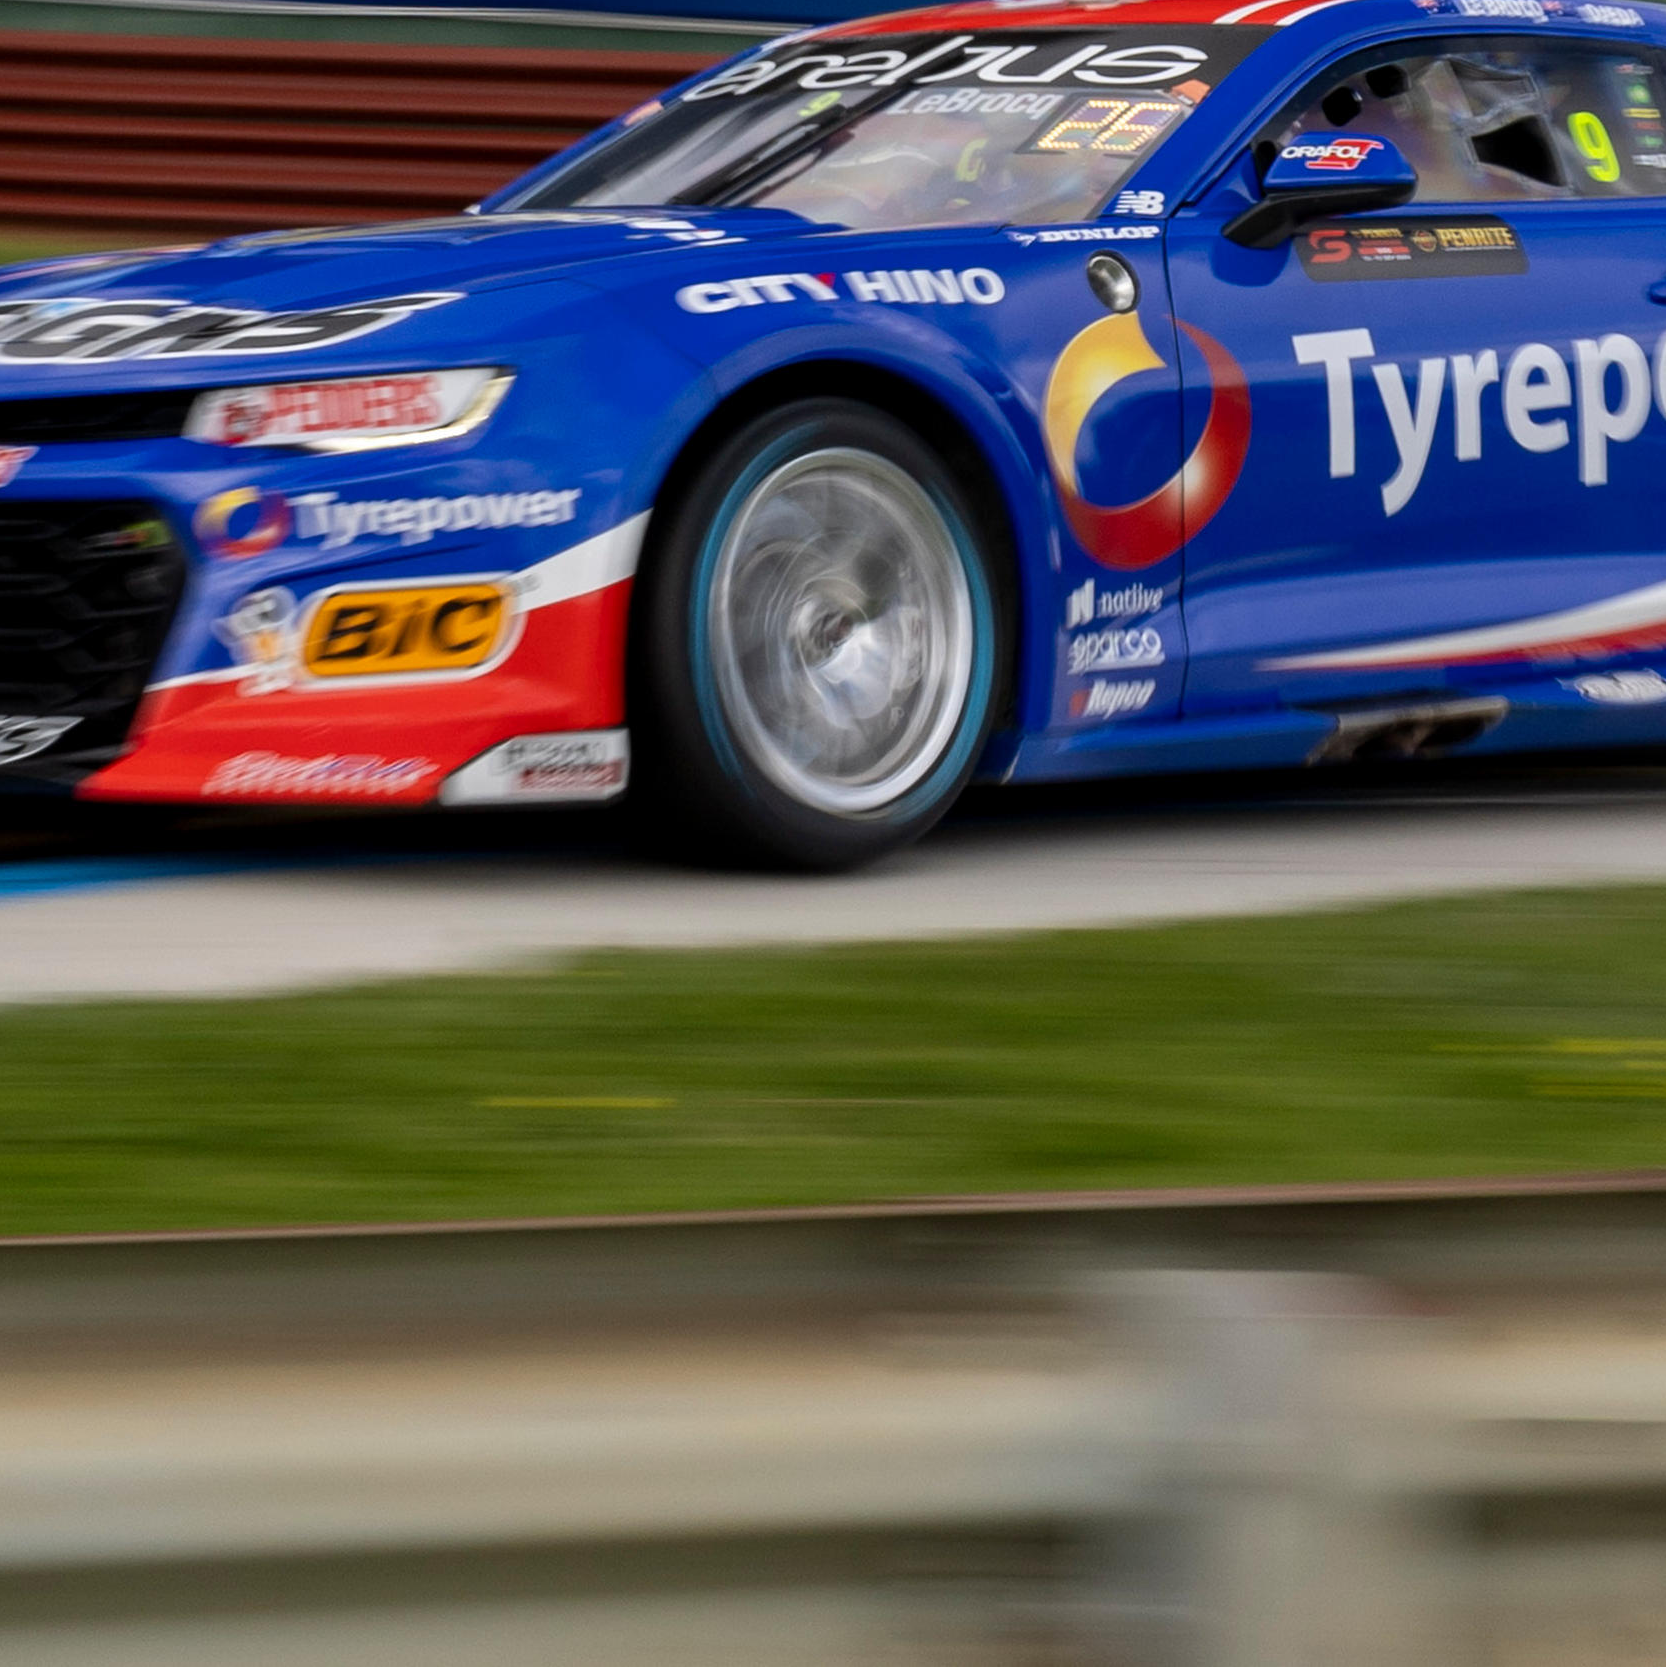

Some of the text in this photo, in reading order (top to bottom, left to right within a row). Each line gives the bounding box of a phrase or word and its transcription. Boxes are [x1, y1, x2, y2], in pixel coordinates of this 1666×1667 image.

[1281, 145, 1368, 160] ORAFOL
[1567, 111, 1621, 182] 9
[1036, 225, 1160, 243] DUNLOP
[1434, 226, 1517, 247] PENRITE
[674, 267, 1006, 315] CITY HINO
[286, 487, 583, 551] Tyrepower
